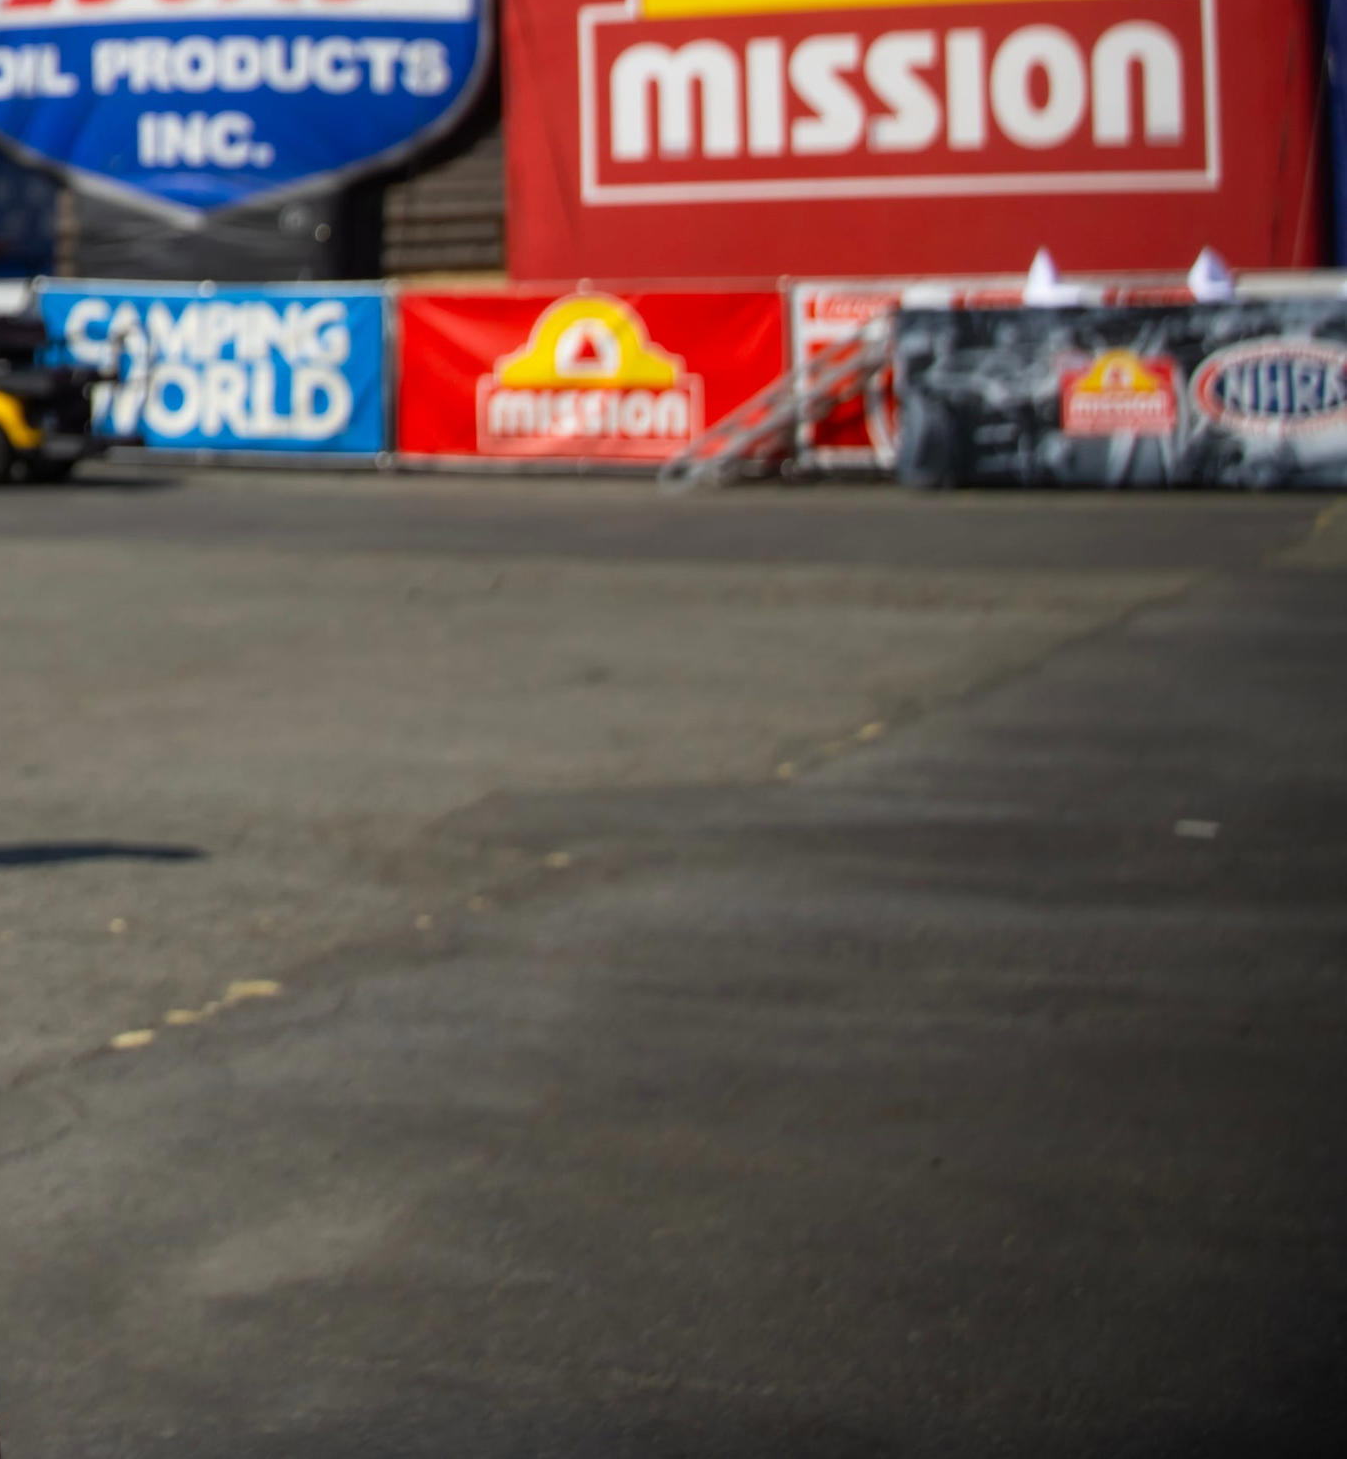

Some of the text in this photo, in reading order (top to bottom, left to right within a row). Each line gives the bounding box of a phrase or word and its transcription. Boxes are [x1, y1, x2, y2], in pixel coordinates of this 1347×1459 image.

[91, 34, 452, 97] PRODUCTS
[608, 20, 1185, 162] MISSION
[136, 111, 275, 168] INC.
[64, 298, 351, 367] CAMPING
[90, 364, 354, 440] WORLD
[486, 391, 690, 438] MISSION
